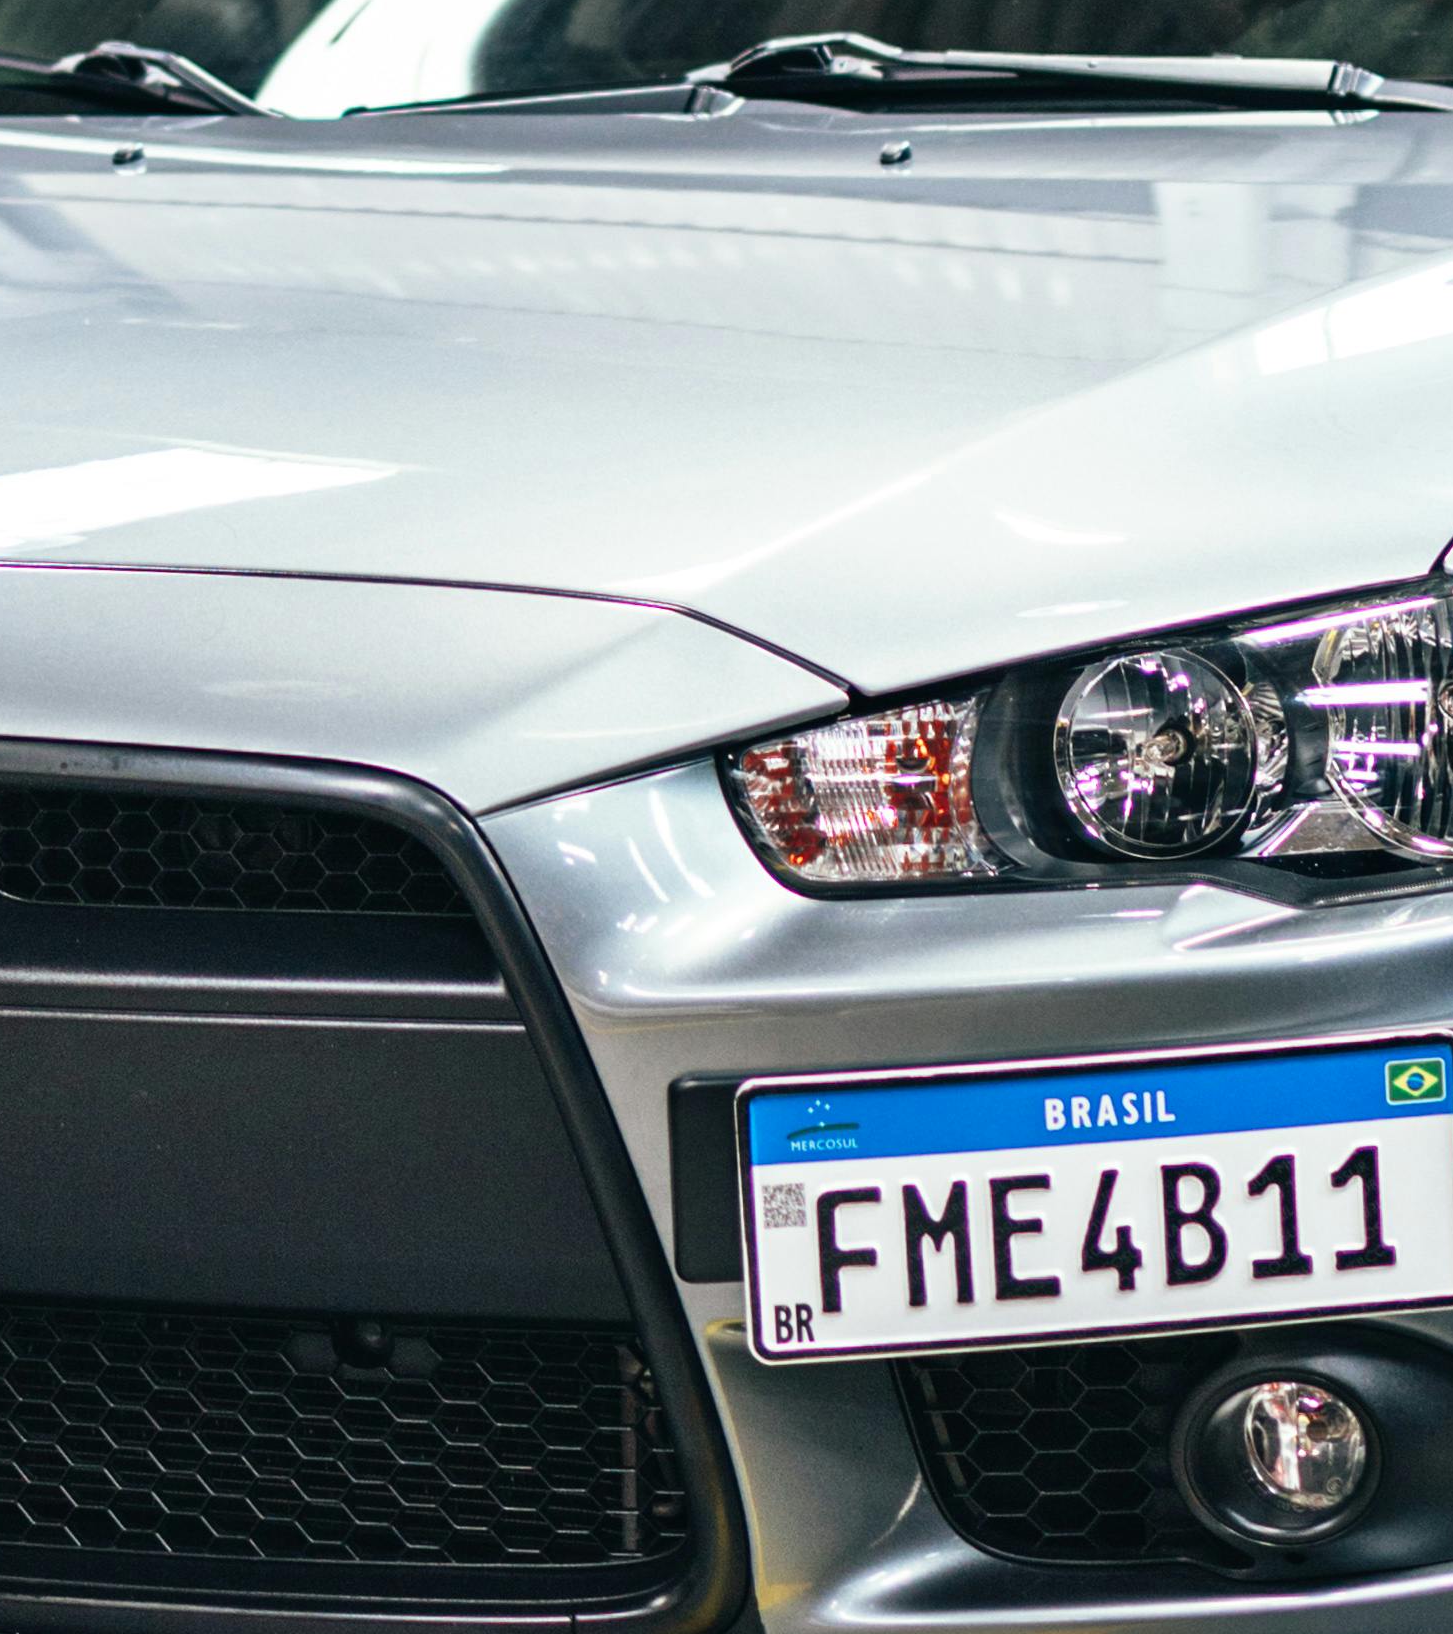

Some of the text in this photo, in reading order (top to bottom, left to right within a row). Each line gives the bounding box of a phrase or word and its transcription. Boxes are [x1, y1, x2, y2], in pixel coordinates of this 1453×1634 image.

[1044, 1091, 1177, 1131] BRASIL
[790, 1138, 859, 1151] MERCOSUL
[815, 1145, 1399, 1314] FME4B11
[773, 1303, 815, 1344] BR
